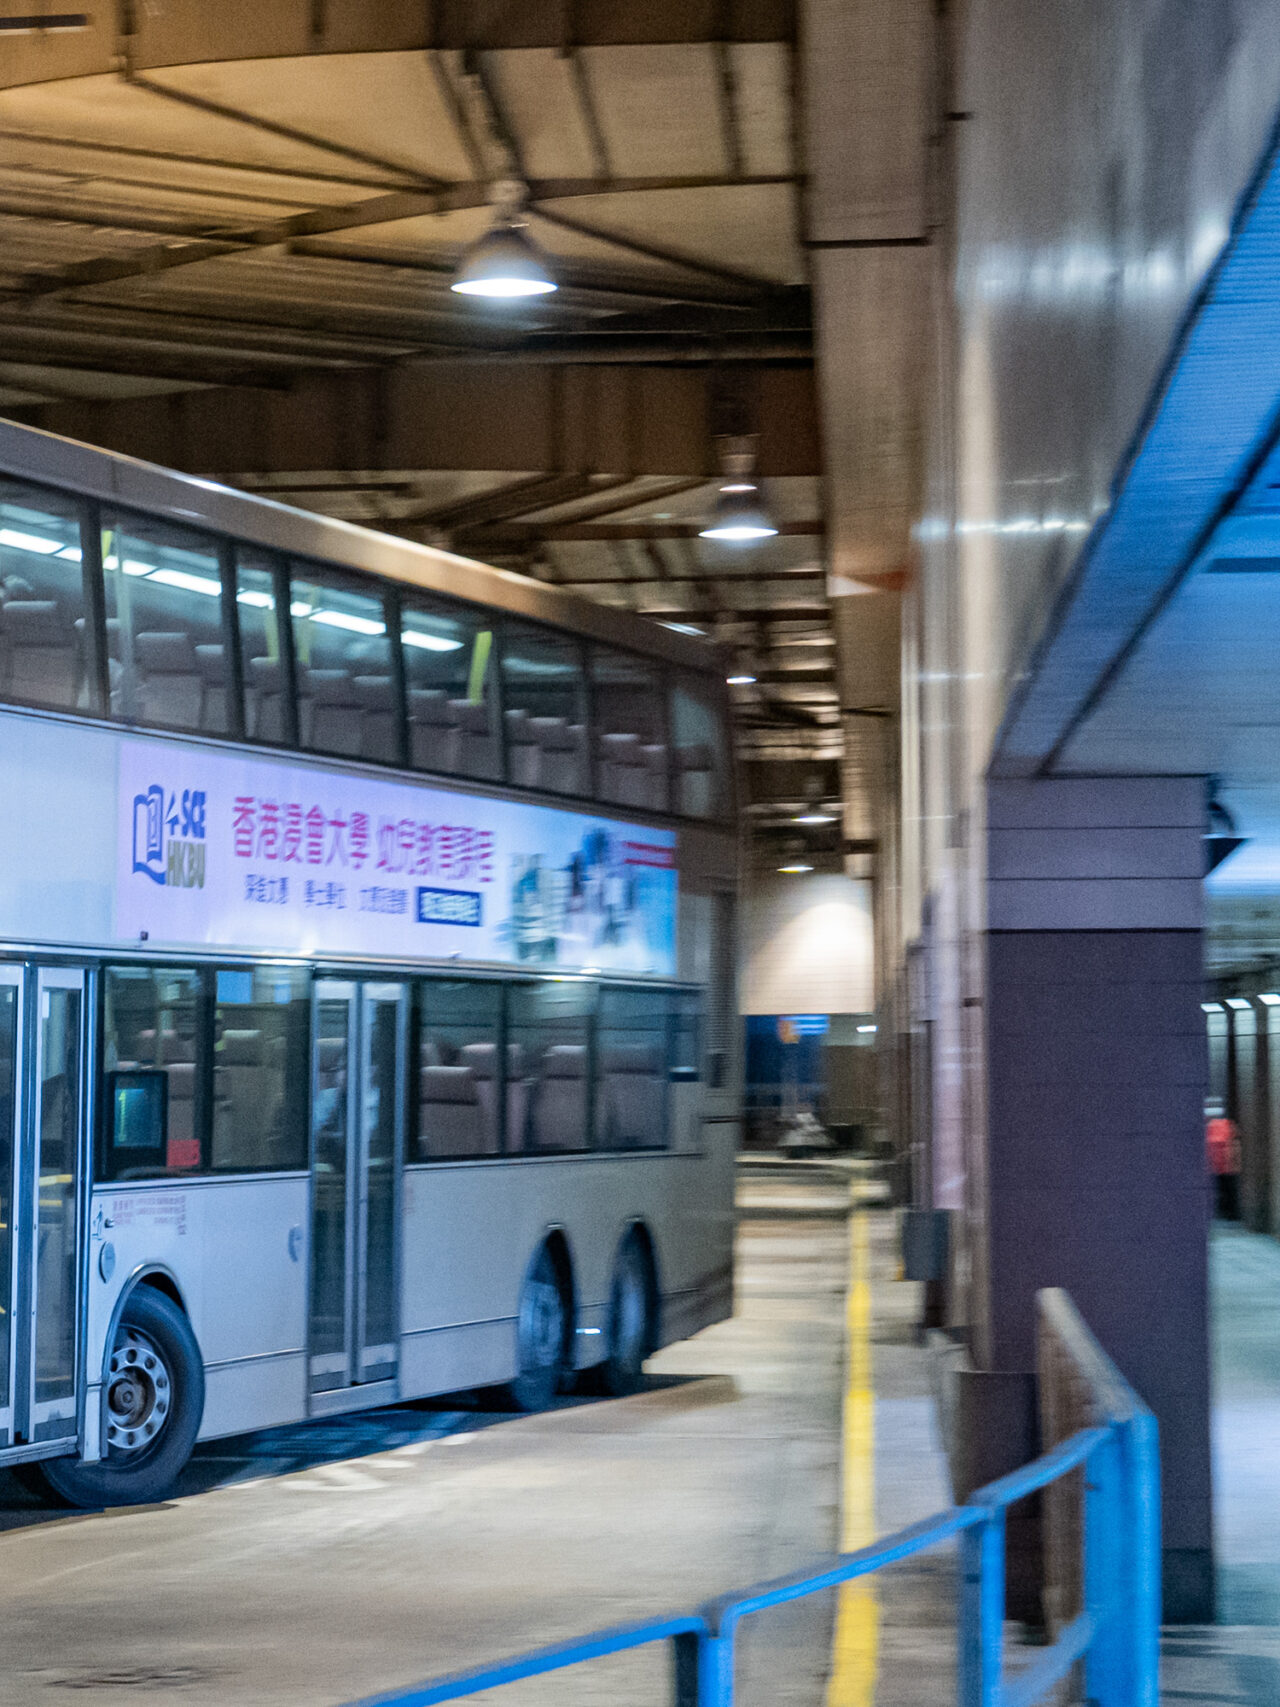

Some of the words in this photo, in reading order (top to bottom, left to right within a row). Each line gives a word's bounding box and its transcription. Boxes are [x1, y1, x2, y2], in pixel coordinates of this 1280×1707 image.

[232, 796, 369, 871] 香港浸會大學
